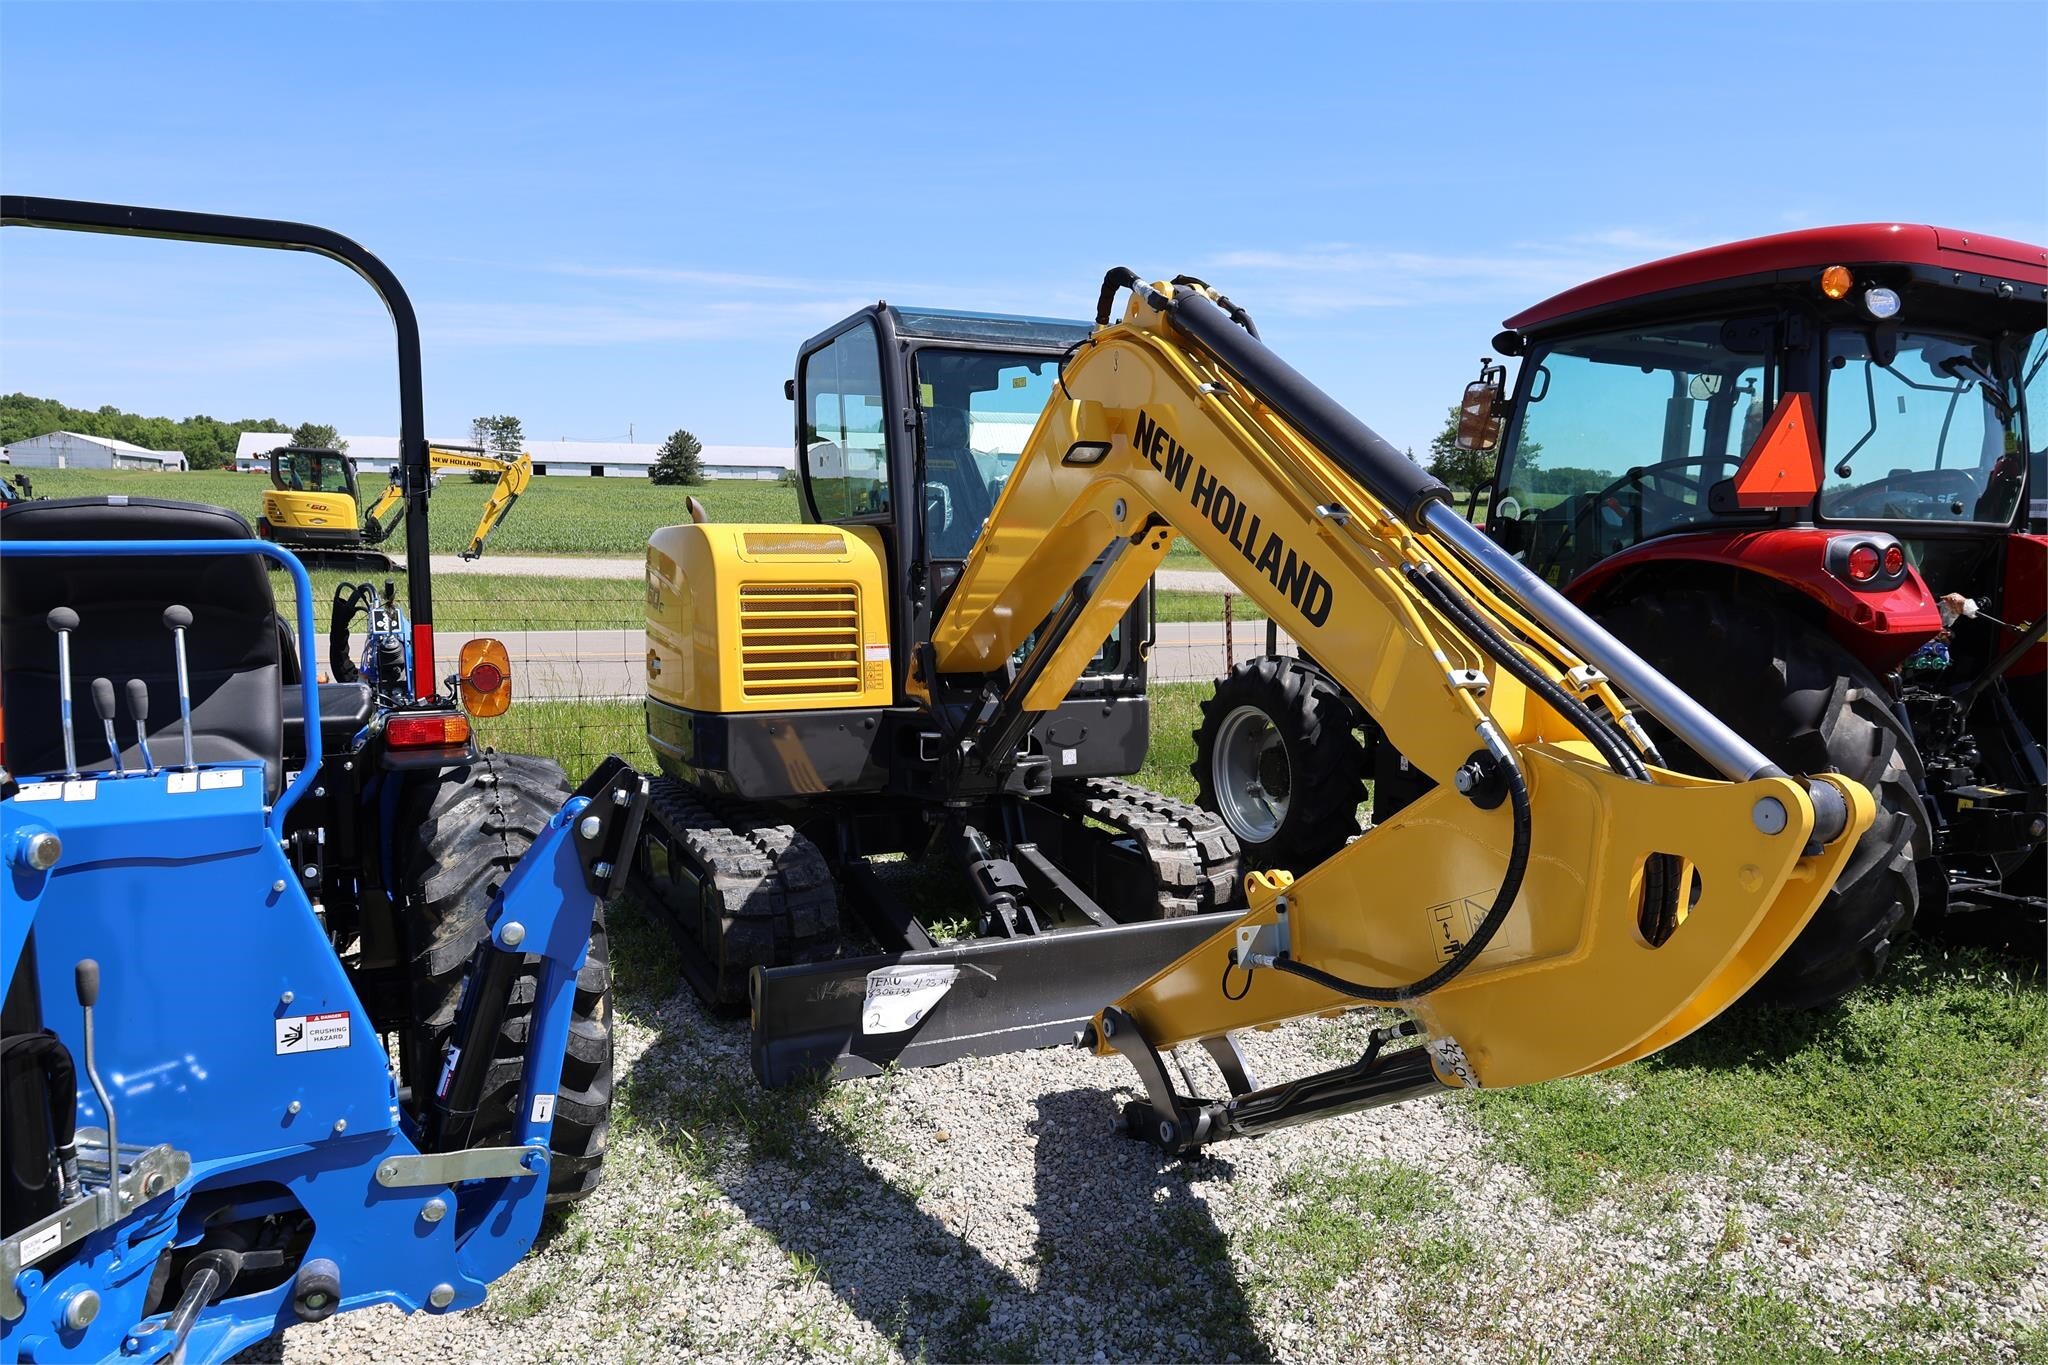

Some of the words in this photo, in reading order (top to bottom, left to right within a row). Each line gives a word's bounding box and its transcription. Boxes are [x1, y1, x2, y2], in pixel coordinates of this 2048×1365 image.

[432, 456, 448, 464] NEW
[449, 459, 482, 467] HOLLAND
[1133, 409, 1194, 492] NEW
[1190, 464, 1333, 628] HOLLAND
[869, 977, 902, 988] TEMU
[869, 1013, 886, 1028] 2
[309, 1026, 347, 1036] CRUSHING
[314, 1034, 344, 1042] HAZARD
